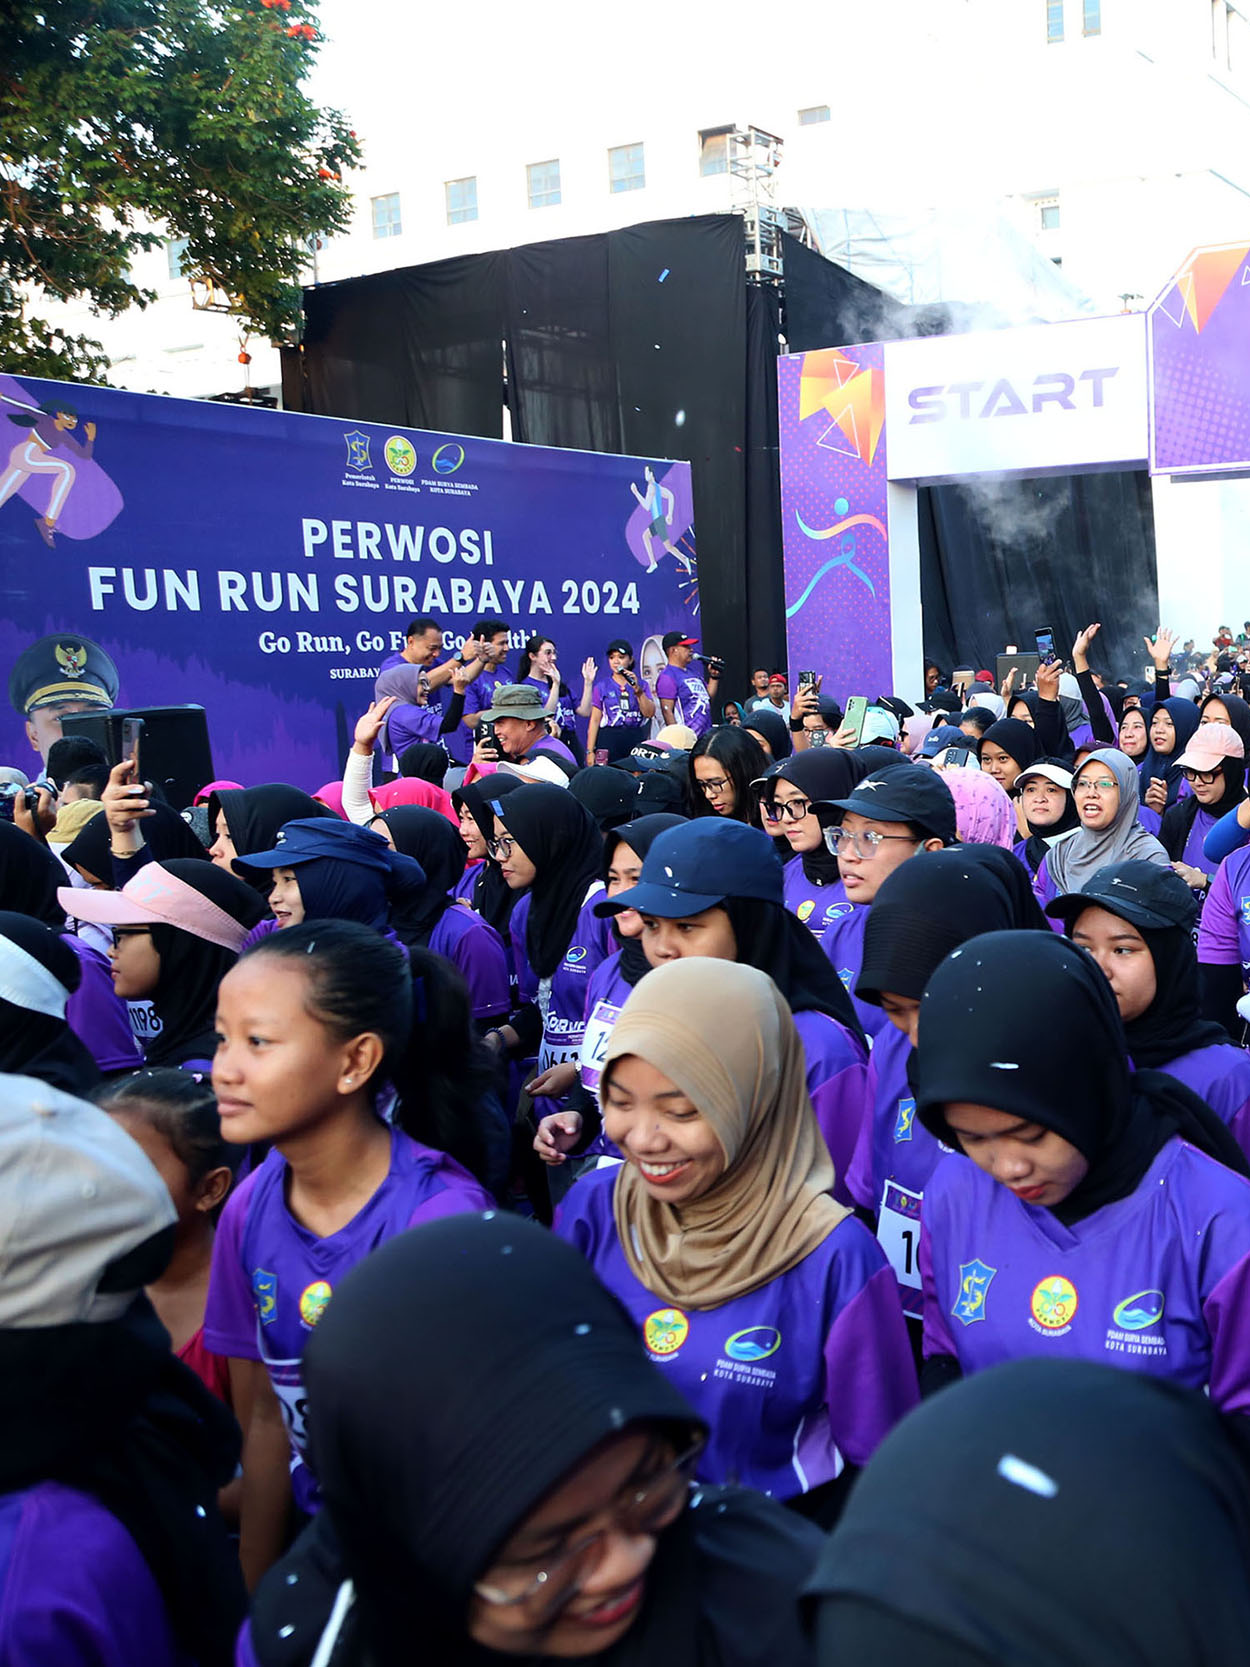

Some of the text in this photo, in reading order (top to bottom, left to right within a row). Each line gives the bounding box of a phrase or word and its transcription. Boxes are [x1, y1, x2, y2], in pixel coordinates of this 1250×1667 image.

[907, 366, 1120, 425] START
[301, 517, 495, 566] PERWOSI
[87, 565, 641, 616] FUN RUN SURABAYA 2024
[258, 631, 292, 654] Go
[296, 631, 351, 656] Run,
[356, 631, 385, 652] Go
[329, 667, 381, 680] SURABAY
[630, 746, 659, 760] ORT
[1105, 1339, 1168, 1356] KOTA SURABAYA
[713, 1367, 734, 1380] KOTA
